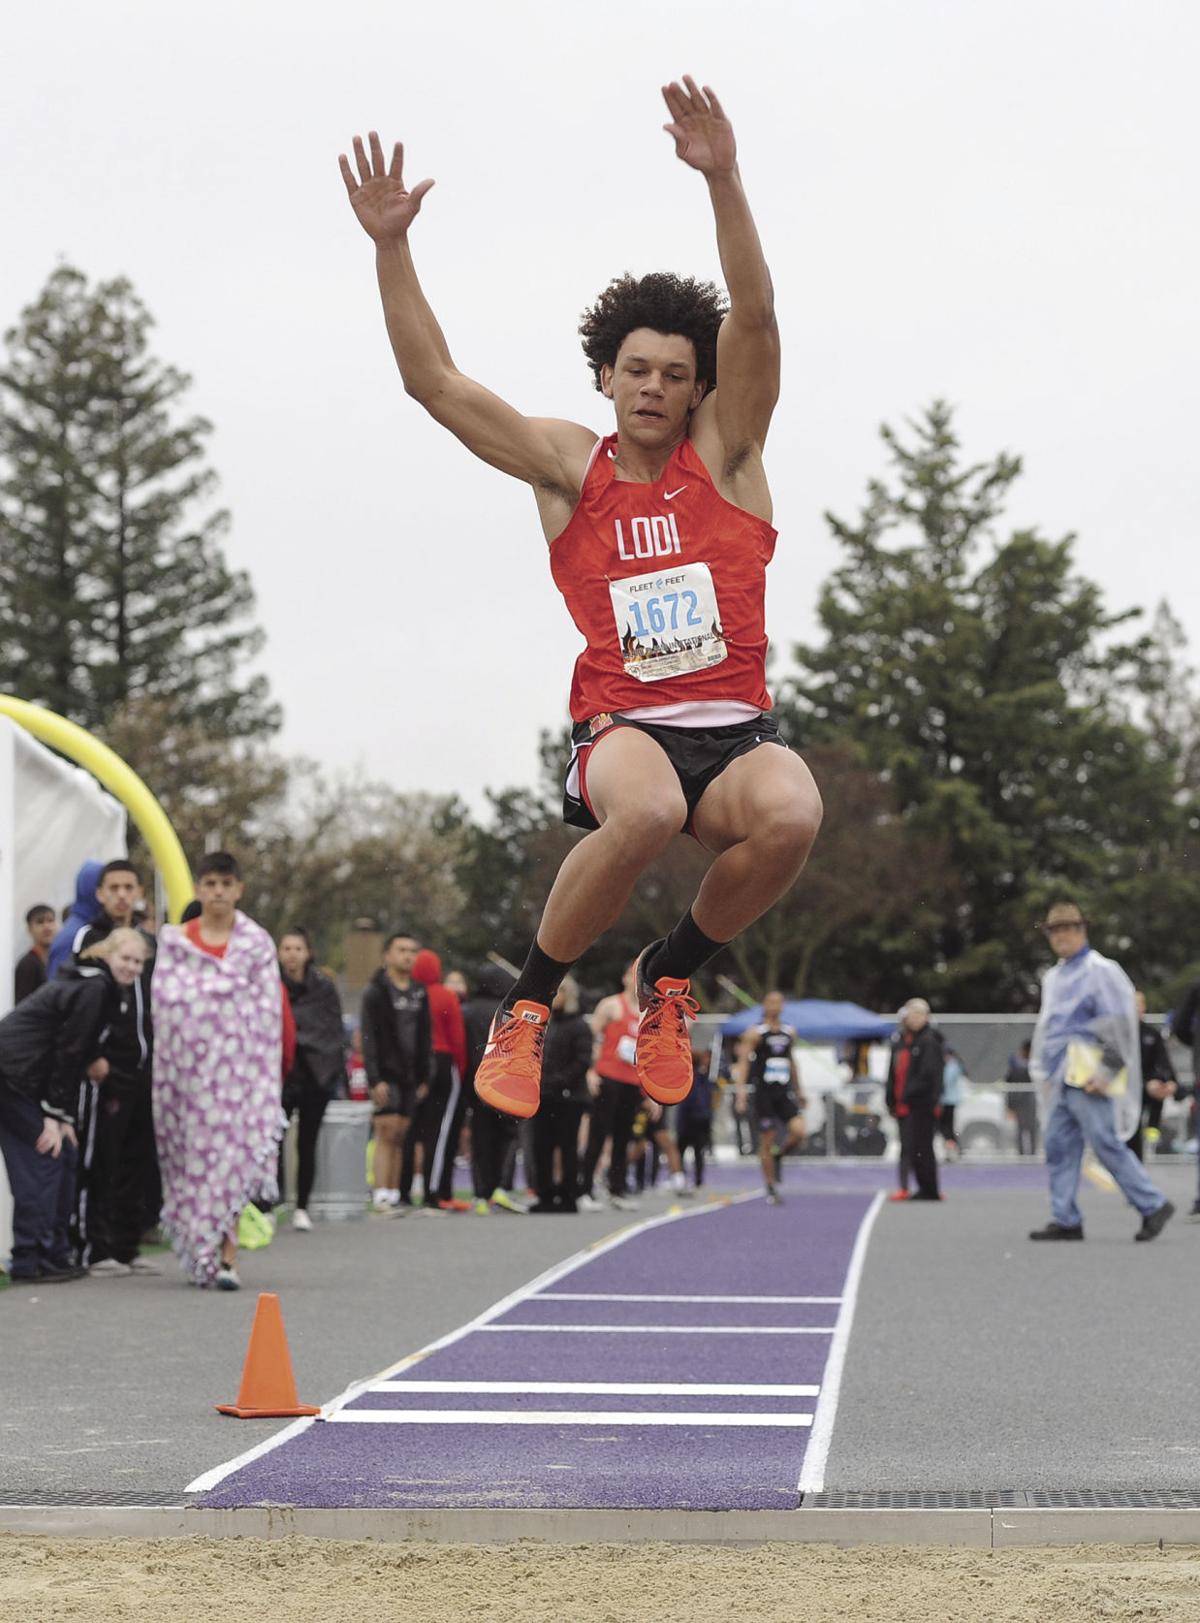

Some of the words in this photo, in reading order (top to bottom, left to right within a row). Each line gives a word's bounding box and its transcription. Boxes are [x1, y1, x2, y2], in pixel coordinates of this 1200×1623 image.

[614, 513, 682, 561] LODI
[629, 581, 654, 593] FLEET
[665, 574, 687, 586] FEET
[629, 590, 703, 638] 1672
[524, 1012, 540, 1022] NIKE
